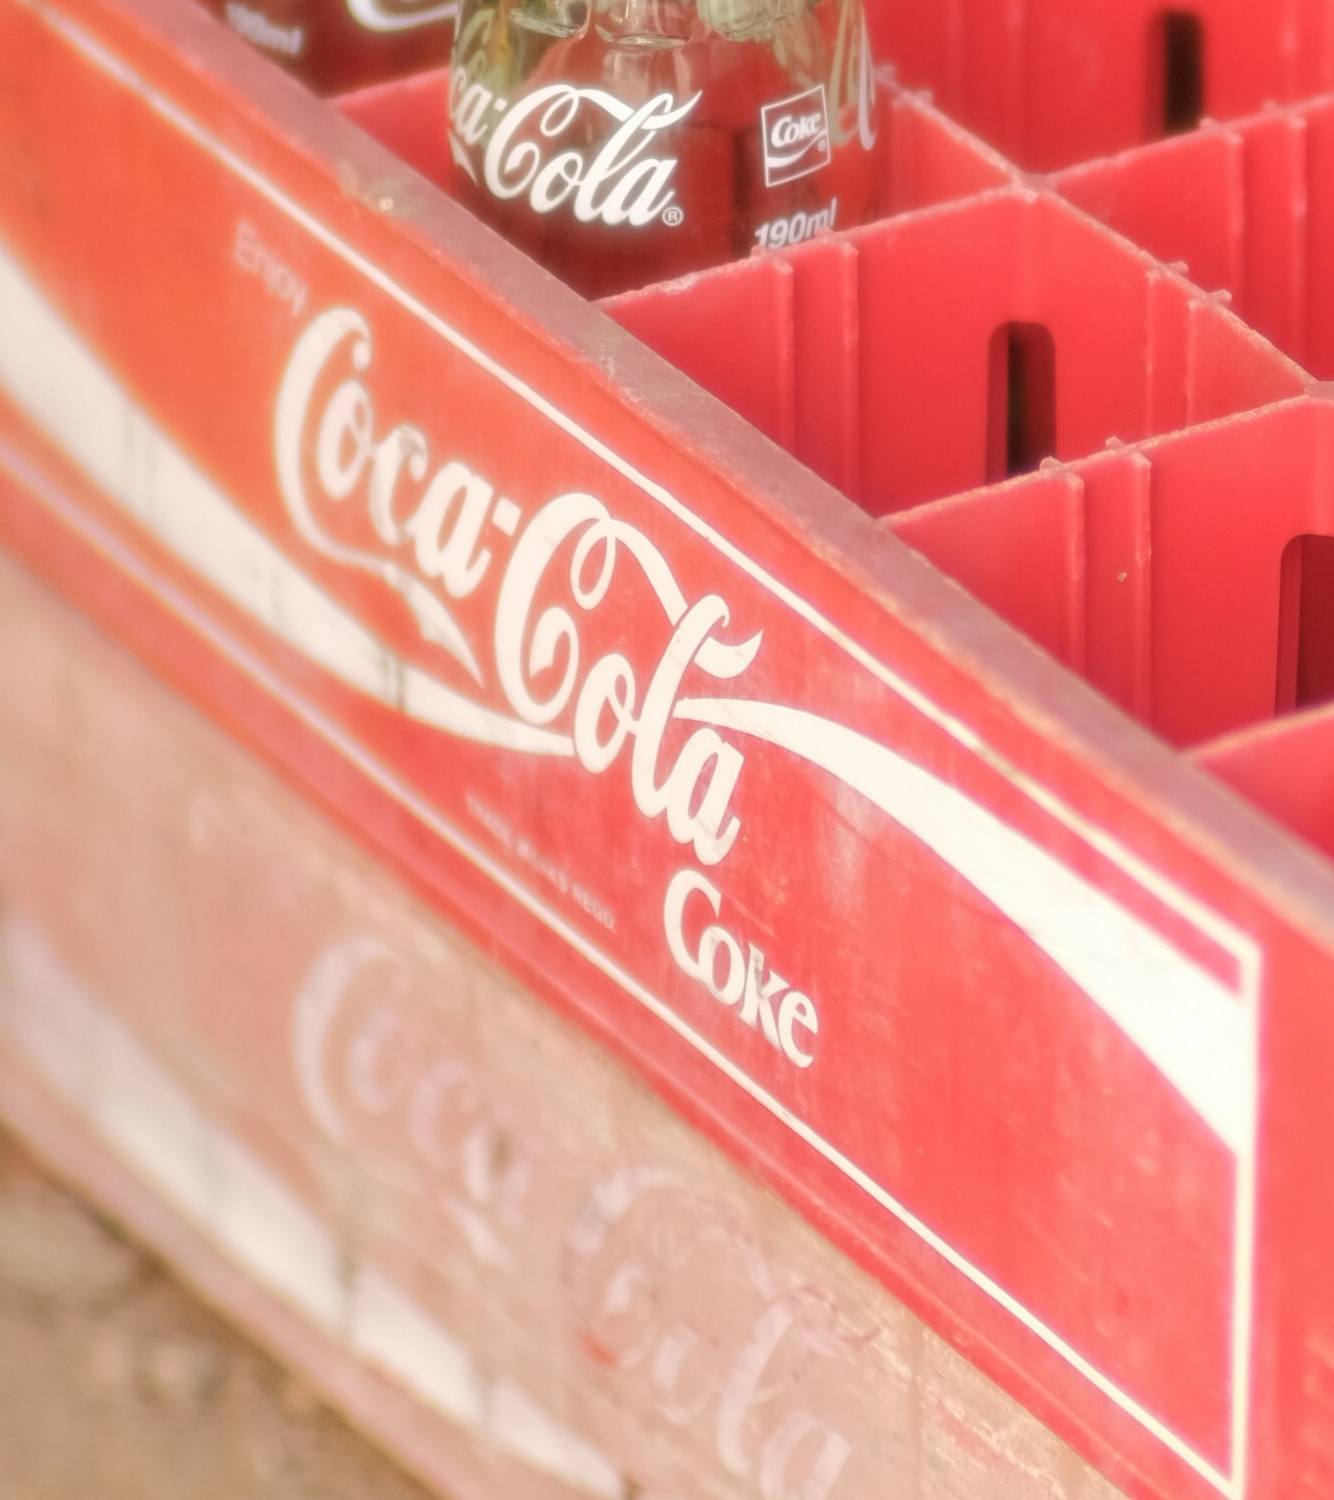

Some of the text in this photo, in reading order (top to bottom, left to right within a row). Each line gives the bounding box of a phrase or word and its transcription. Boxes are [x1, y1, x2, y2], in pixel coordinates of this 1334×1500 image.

[771, 112, 822, 148] Coke
[234, 220, 308, 317] Enjoy
[755, 197, 838, 250] 190ml
[273, 307, 764, 867] Coca-Cola
[663, 868, 819, 1069] Coke
